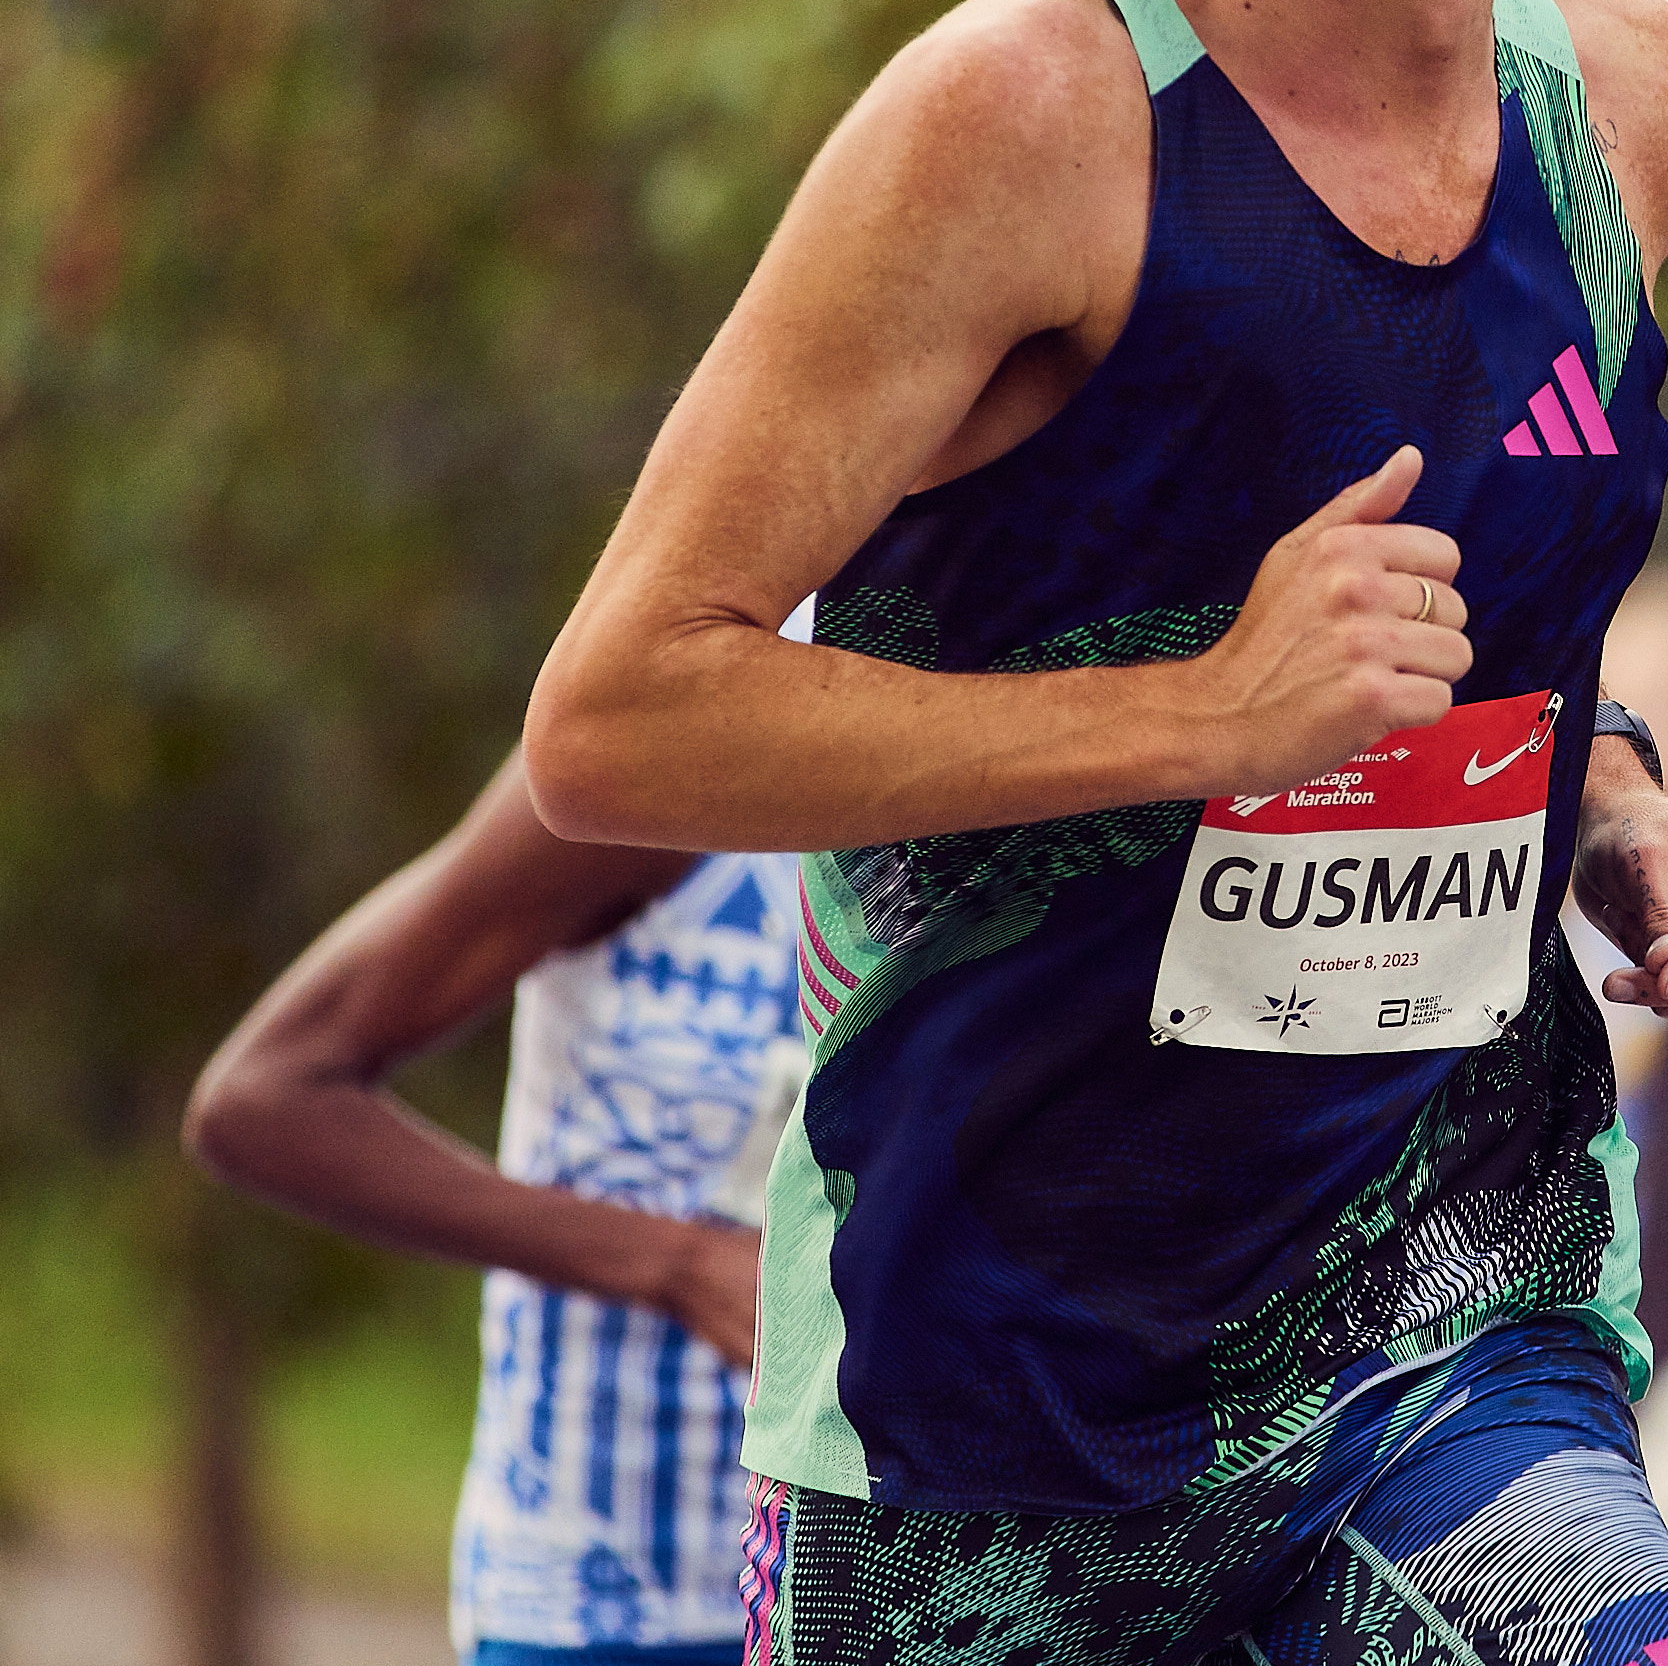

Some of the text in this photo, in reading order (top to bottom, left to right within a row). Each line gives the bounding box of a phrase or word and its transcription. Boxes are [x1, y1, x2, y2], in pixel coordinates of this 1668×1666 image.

[1287, 789, 1374, 808] Marathon
[1199, 843, 1530, 930] GUSMAN
[1299, 952, 1420, 973] October 8, 2023
[1415, 994, 1442, 1004] ABBOTT
[1414, 1002, 1439, 1011] WORLD
[1412, 1007, 1453, 1018] MARATHON
[1411, 1016, 1440, 1025] MAJORS
